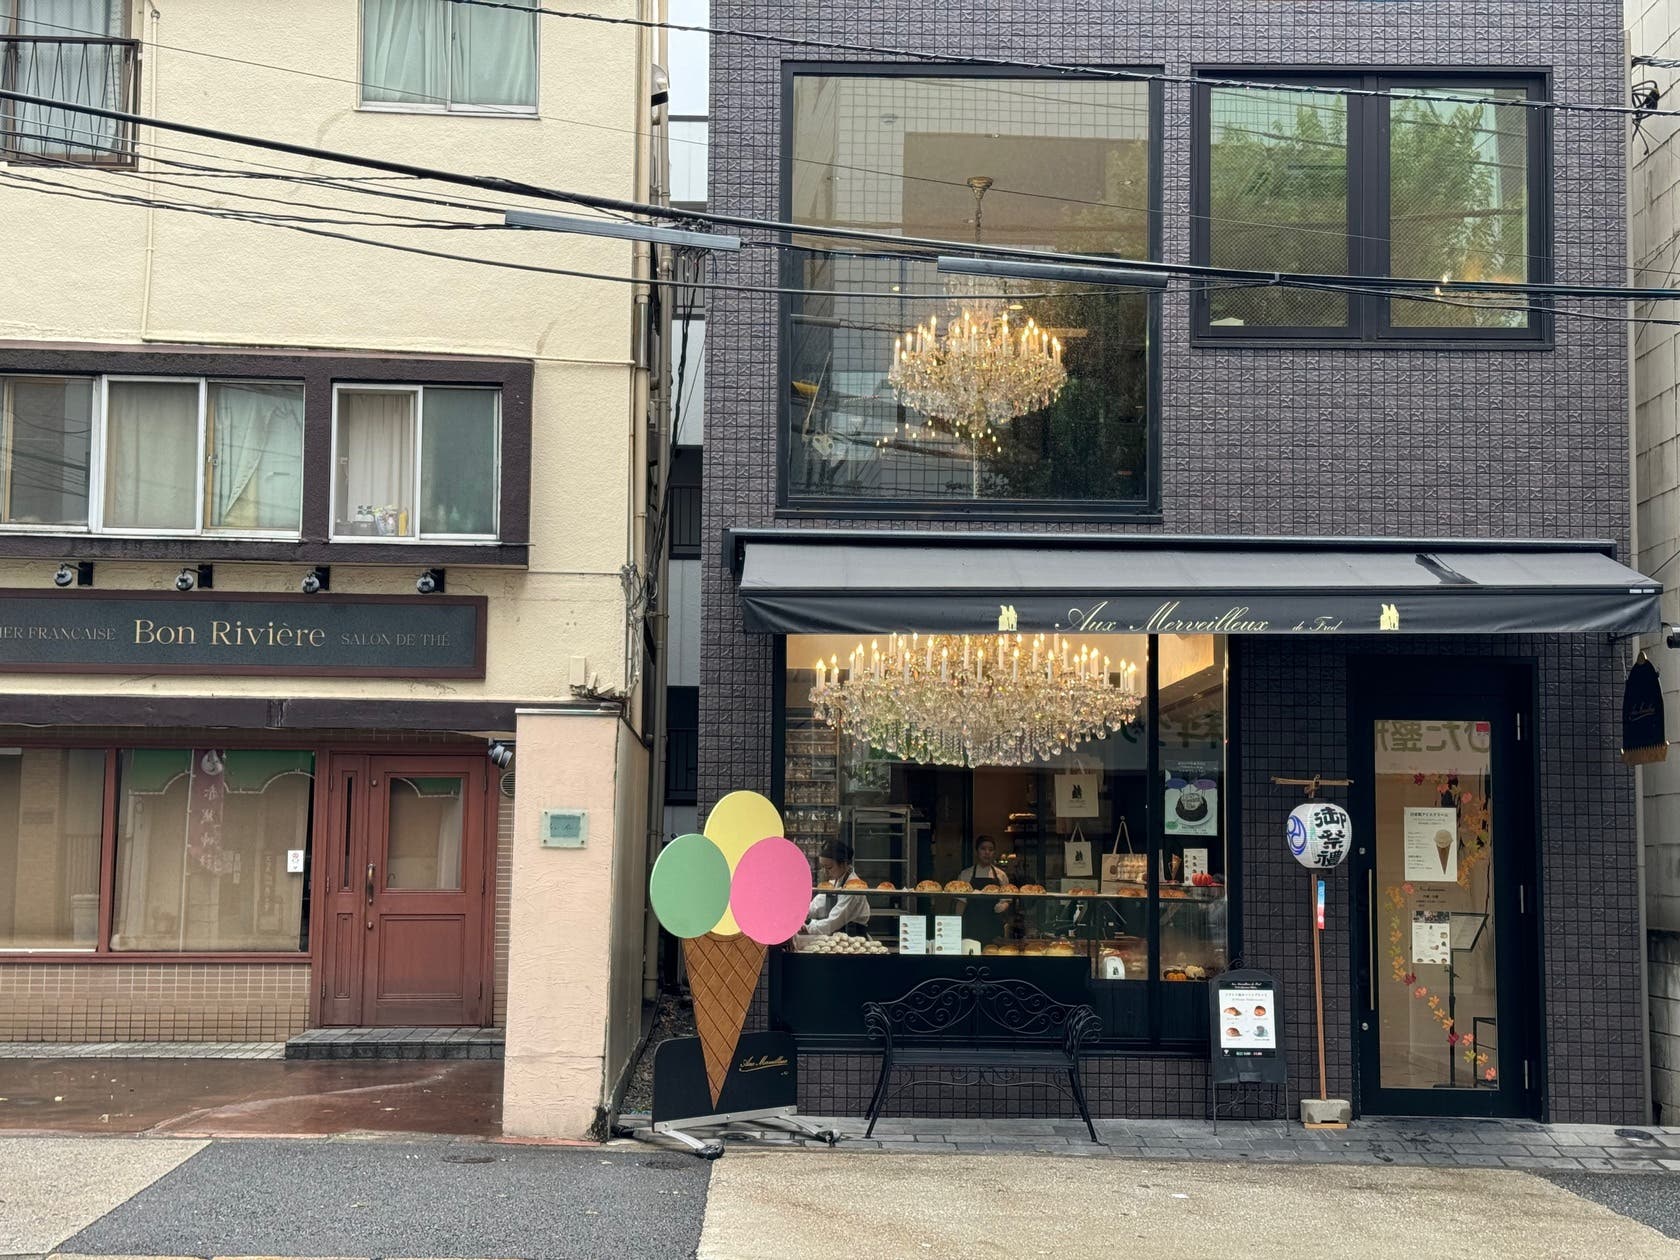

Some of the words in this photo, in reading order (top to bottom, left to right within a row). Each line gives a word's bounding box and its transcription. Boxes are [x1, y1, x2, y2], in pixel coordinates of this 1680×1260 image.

[1055, 601, 1117, 633] Aux
[1129, 601, 1269, 633] Merveilleux
[1292, 621, 1305, 632] de
[134, 618, 197, 645] Bon
[211, 620, 326, 648] Rivière
[340, 632, 392, 647] SALON
[396, 633, 416, 647] DE
